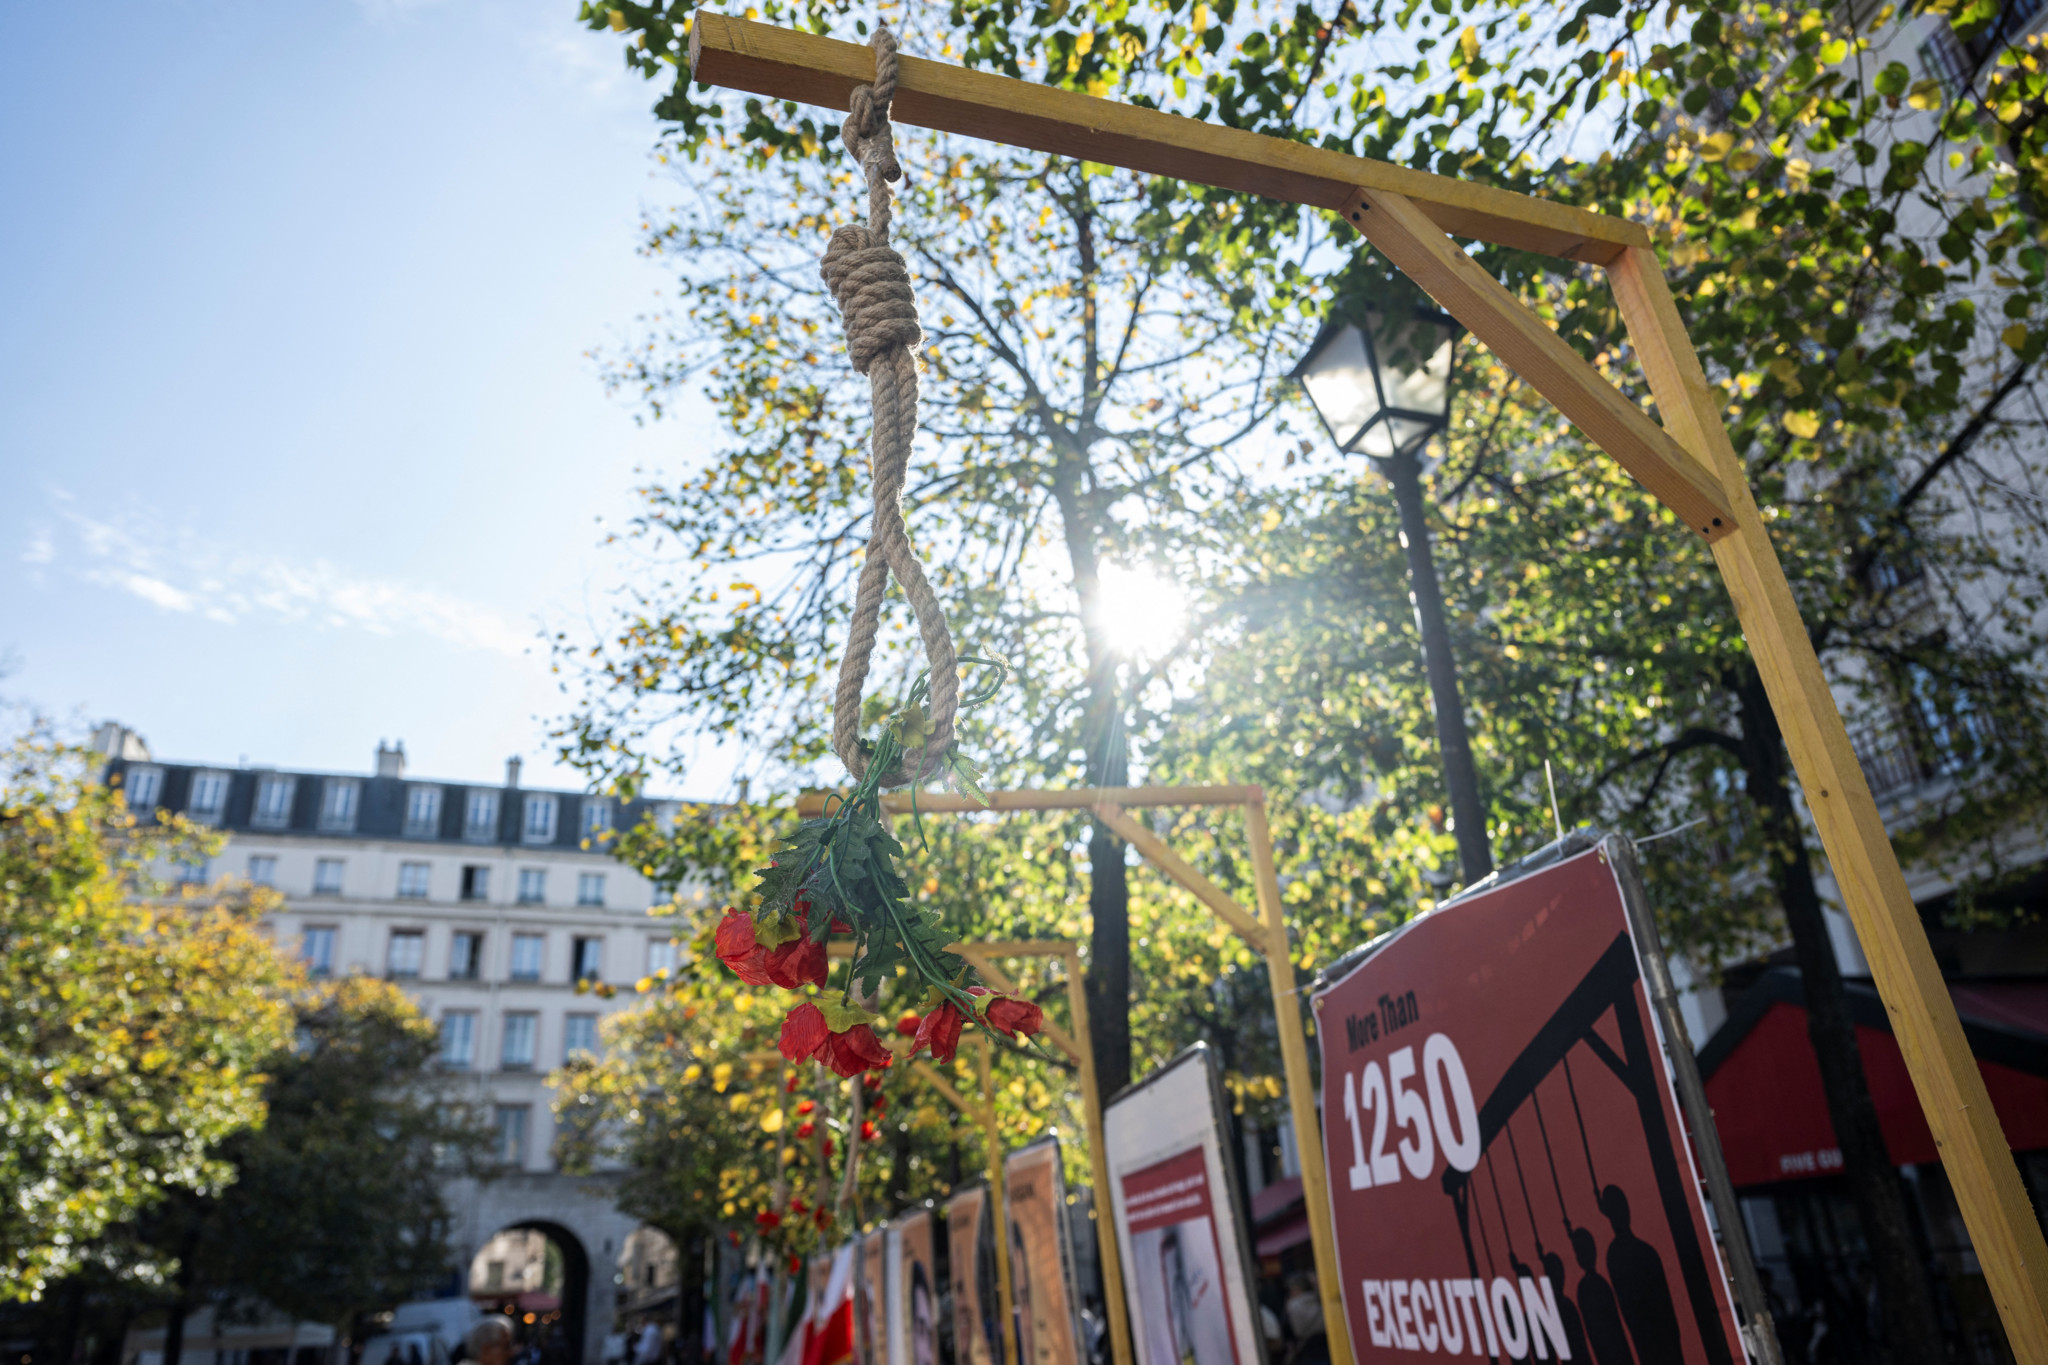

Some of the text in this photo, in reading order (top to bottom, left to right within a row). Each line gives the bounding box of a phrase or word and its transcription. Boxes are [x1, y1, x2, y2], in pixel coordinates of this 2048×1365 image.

[1346, 990, 1420, 1054] More Than
[1343, 1033, 1481, 1190] 1250
[1362, 1275, 1572, 1361] EXECUTION
